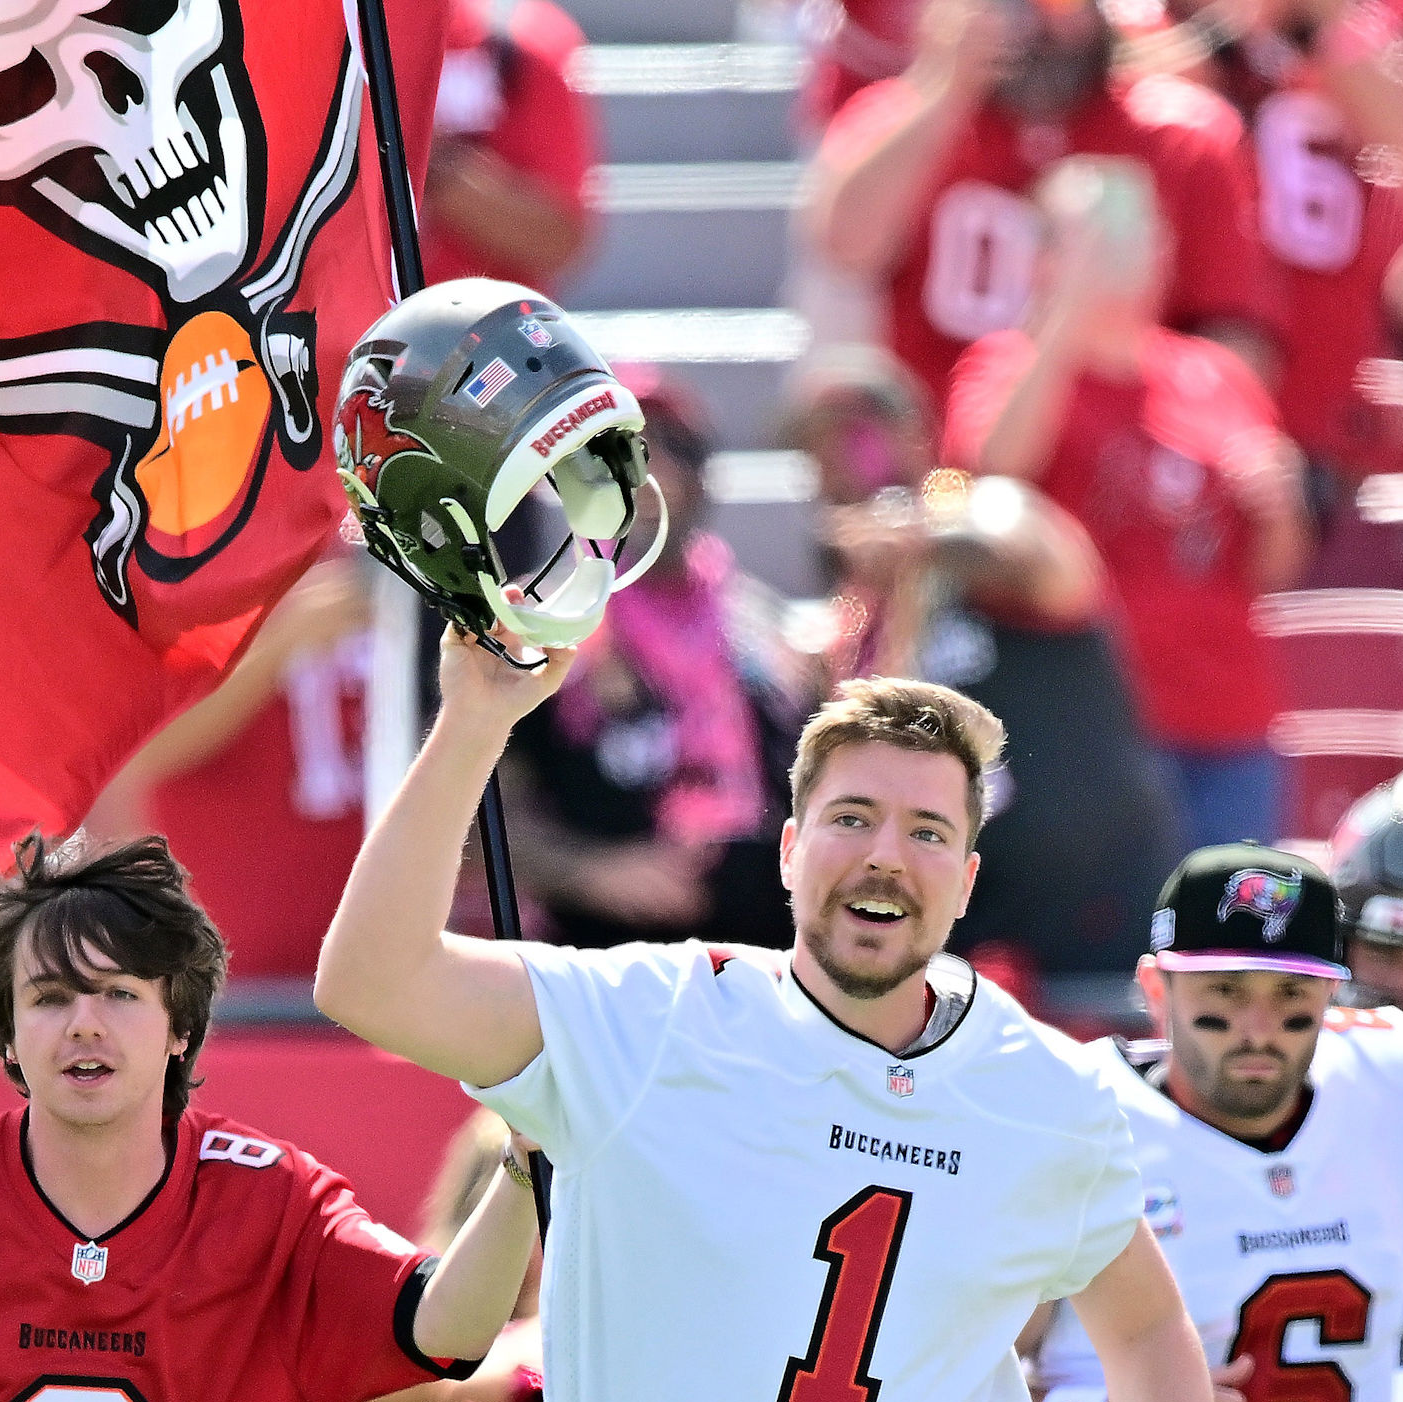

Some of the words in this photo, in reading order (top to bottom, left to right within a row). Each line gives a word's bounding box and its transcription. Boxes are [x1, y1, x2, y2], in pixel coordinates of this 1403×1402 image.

[530, 389, 619, 458] BUCCANEERS
[829, 1123, 962, 1177] BUCCANEERS
[75, 1257, 106, 1278] NFL
[18, 1322, 147, 1358] BUCCANEERS
